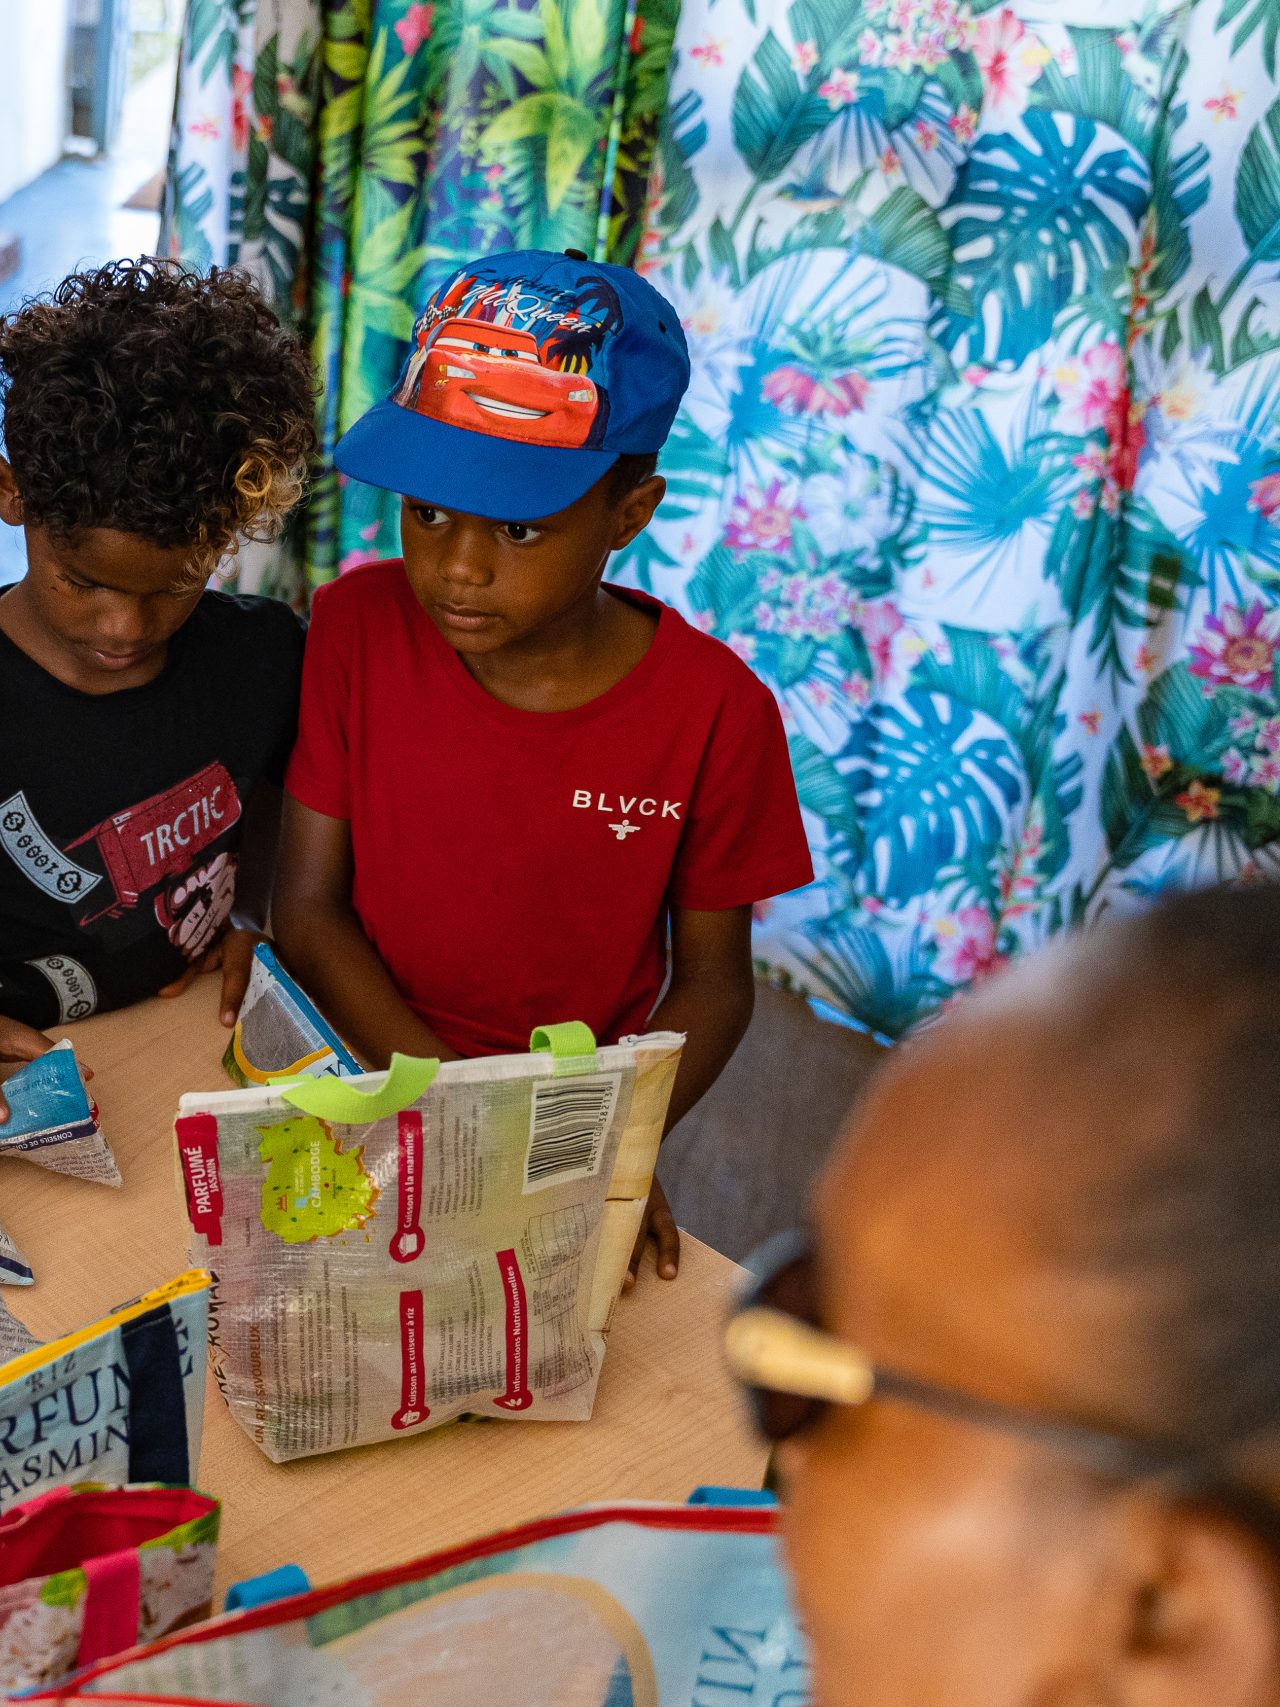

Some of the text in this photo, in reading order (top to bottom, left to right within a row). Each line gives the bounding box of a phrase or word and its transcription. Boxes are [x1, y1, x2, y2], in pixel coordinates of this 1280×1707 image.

[462, 283, 592, 333] McQueen
[572, 789, 682, 820] BLVCK
[140, 785, 224, 866] TRCTIC
[404, 1132, 414, 1174] marmite
[184, 1145, 212, 1214] PARFUMÉ
[206, 1157, 219, 1193] JASMIN
[310, 1141, 321, 1208] CAMBODGE
[404, 1175, 414, 1186] la
[403, 1194, 414, 1228] Cuisson
[407, 1307, 415, 1319] riz
[506, 1266, 521, 1392] Informations Nutritionnelles
[249, 1325, 265, 1397] SAVOUREUX
[406, 1328, 416, 1360] cuiseur
[409, 1362, 417, 1373] au
[407, 1375, 418, 1407] Cuisson
